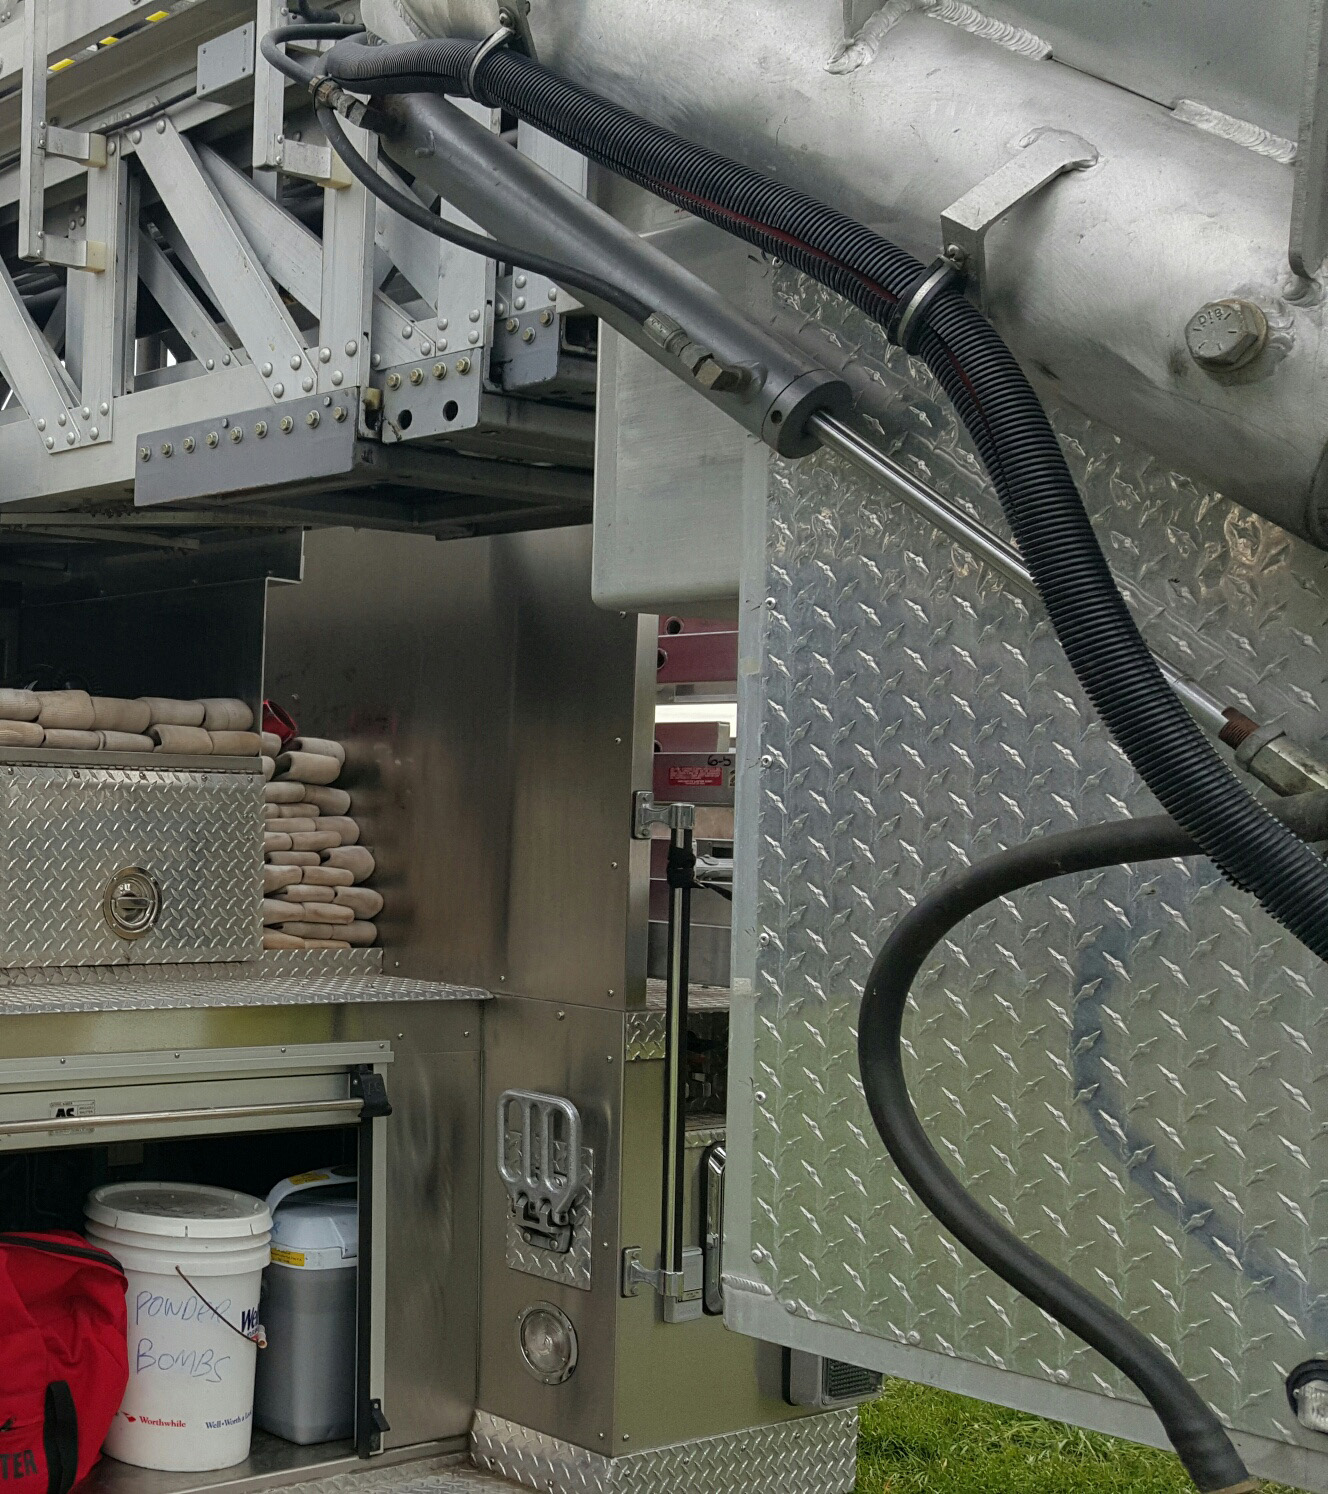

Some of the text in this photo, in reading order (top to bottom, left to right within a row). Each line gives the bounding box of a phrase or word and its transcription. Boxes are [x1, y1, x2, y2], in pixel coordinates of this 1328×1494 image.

[136, 1290, 232, 1326] POWDER
[136, 1338, 231, 1383] BOMBS
[139, 1416, 187, 1429] Worthwhile
